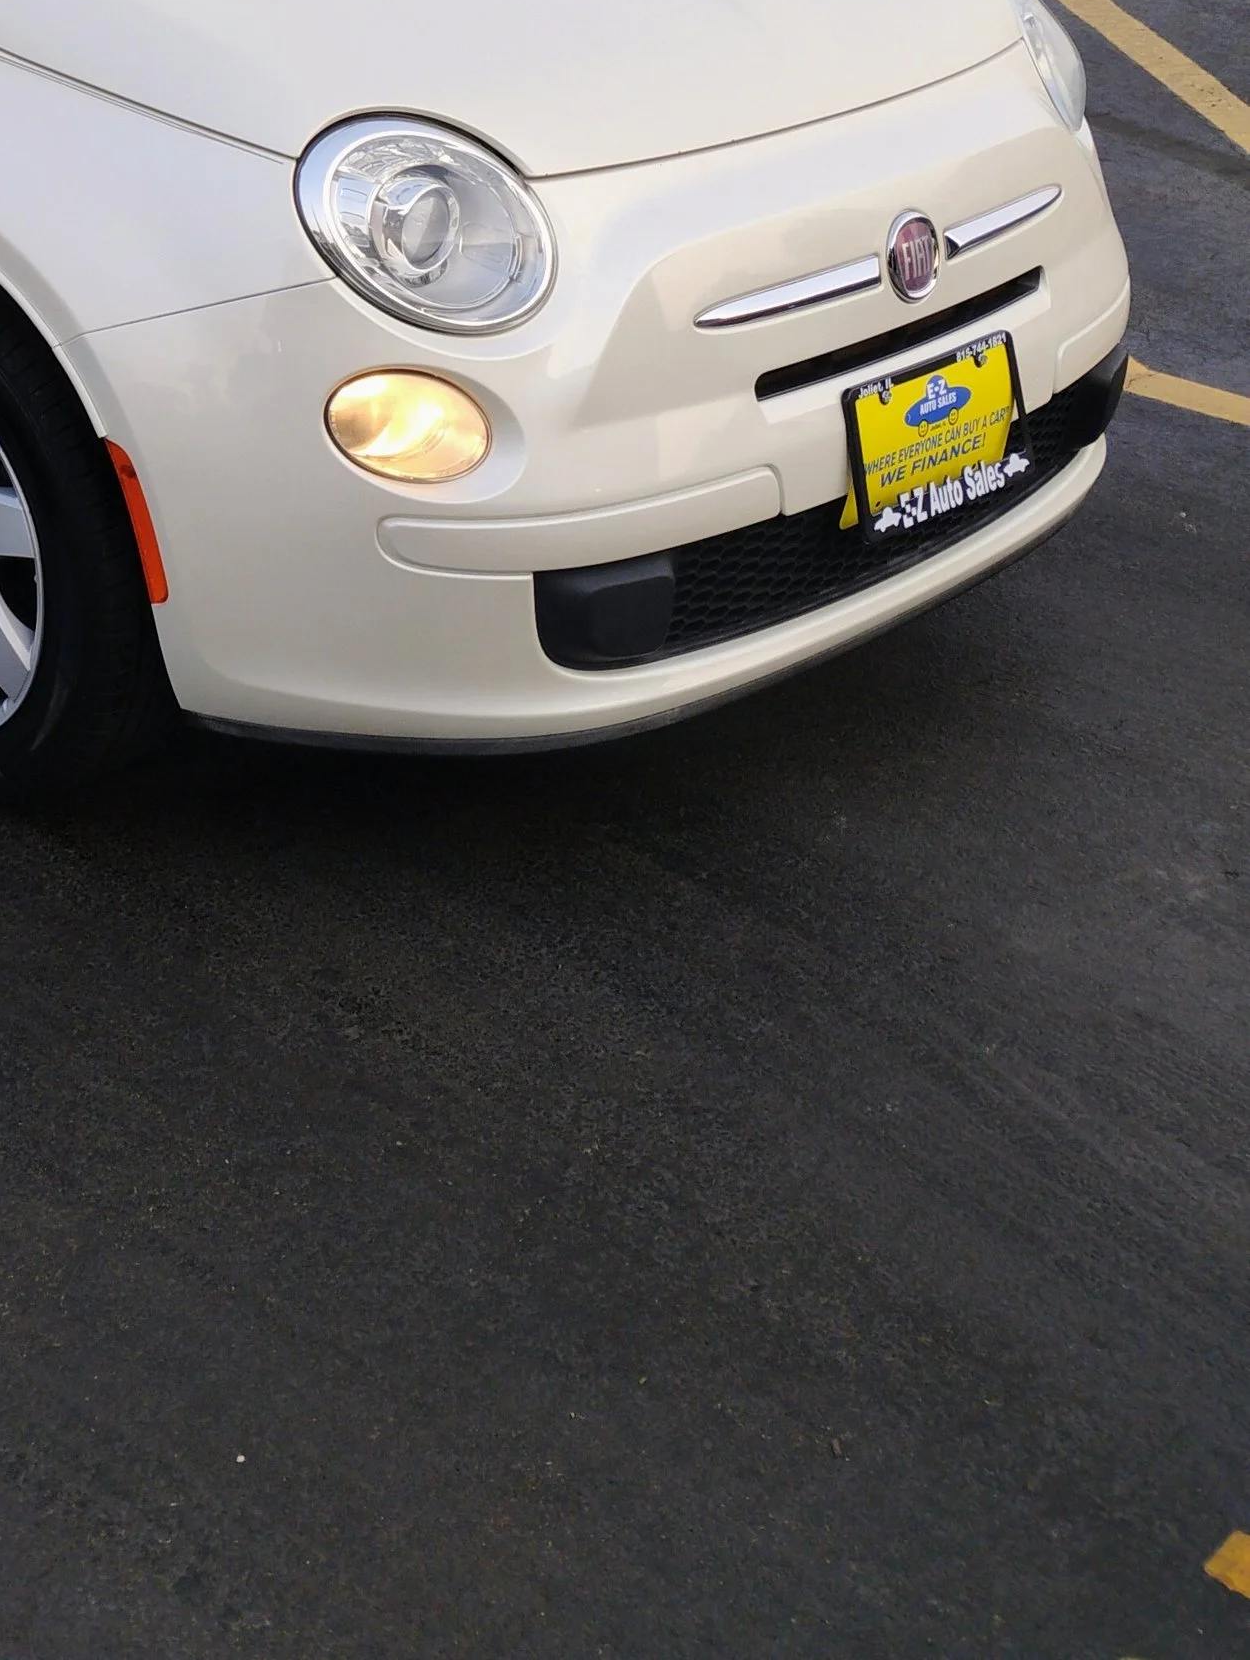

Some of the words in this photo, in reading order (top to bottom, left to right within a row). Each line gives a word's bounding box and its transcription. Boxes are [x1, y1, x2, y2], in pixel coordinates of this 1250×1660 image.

[901, 234, 929, 281] FIAT
[858, 381, 884, 399] Joliet
[919, 400, 937, 417] AUTO
[937, 391, 958, 410] SALES
[880, 464, 907, 488] WE
[910, 432, 987, 477] FINANCE!
[897, 435, 943, 463] EVERYONE
[944, 427, 962, 446] CAN
[962, 417, 981, 437] BUY
[980, 414, 988, 431] A
[929, 476, 964, 518] Auto
[963, 460, 1006, 501] Sales
